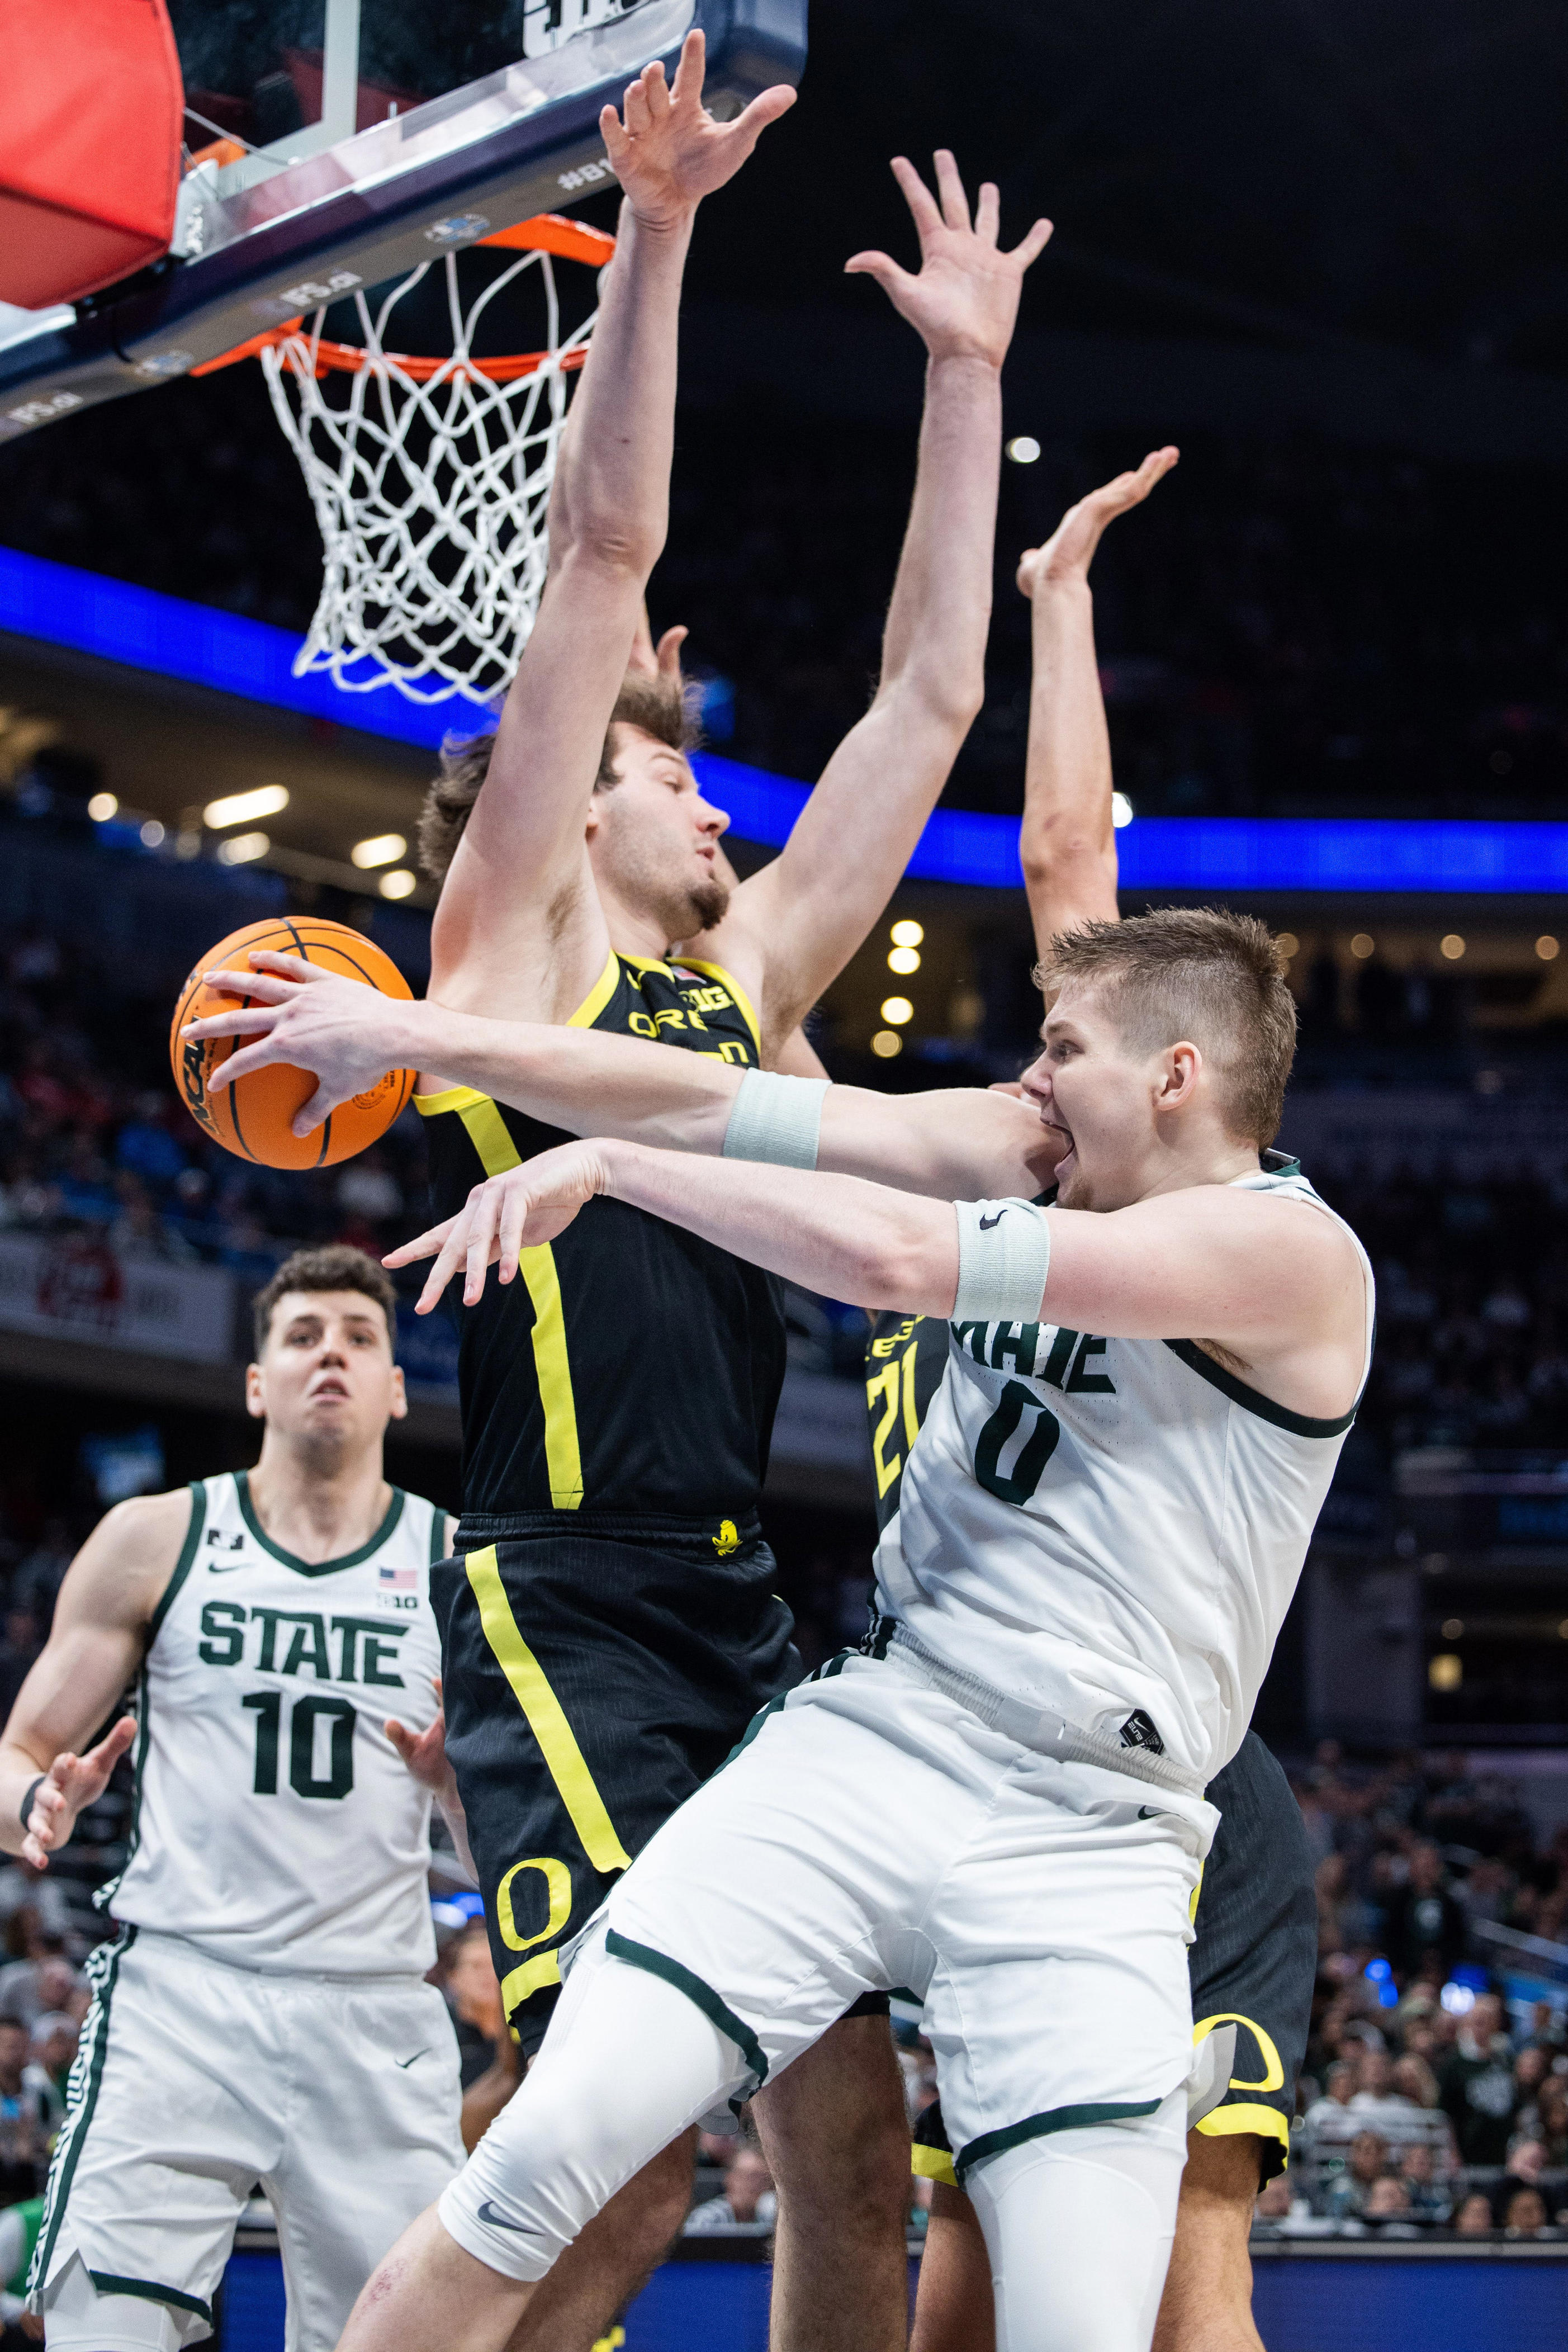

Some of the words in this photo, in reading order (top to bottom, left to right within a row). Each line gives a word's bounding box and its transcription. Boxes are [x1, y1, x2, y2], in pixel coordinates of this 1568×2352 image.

[974, 1379, 1060, 1506] 0
[199, 1601, 410, 1688] STATE
[242, 1691, 358, 1800] 10
[497, 1857, 572, 1951] O
